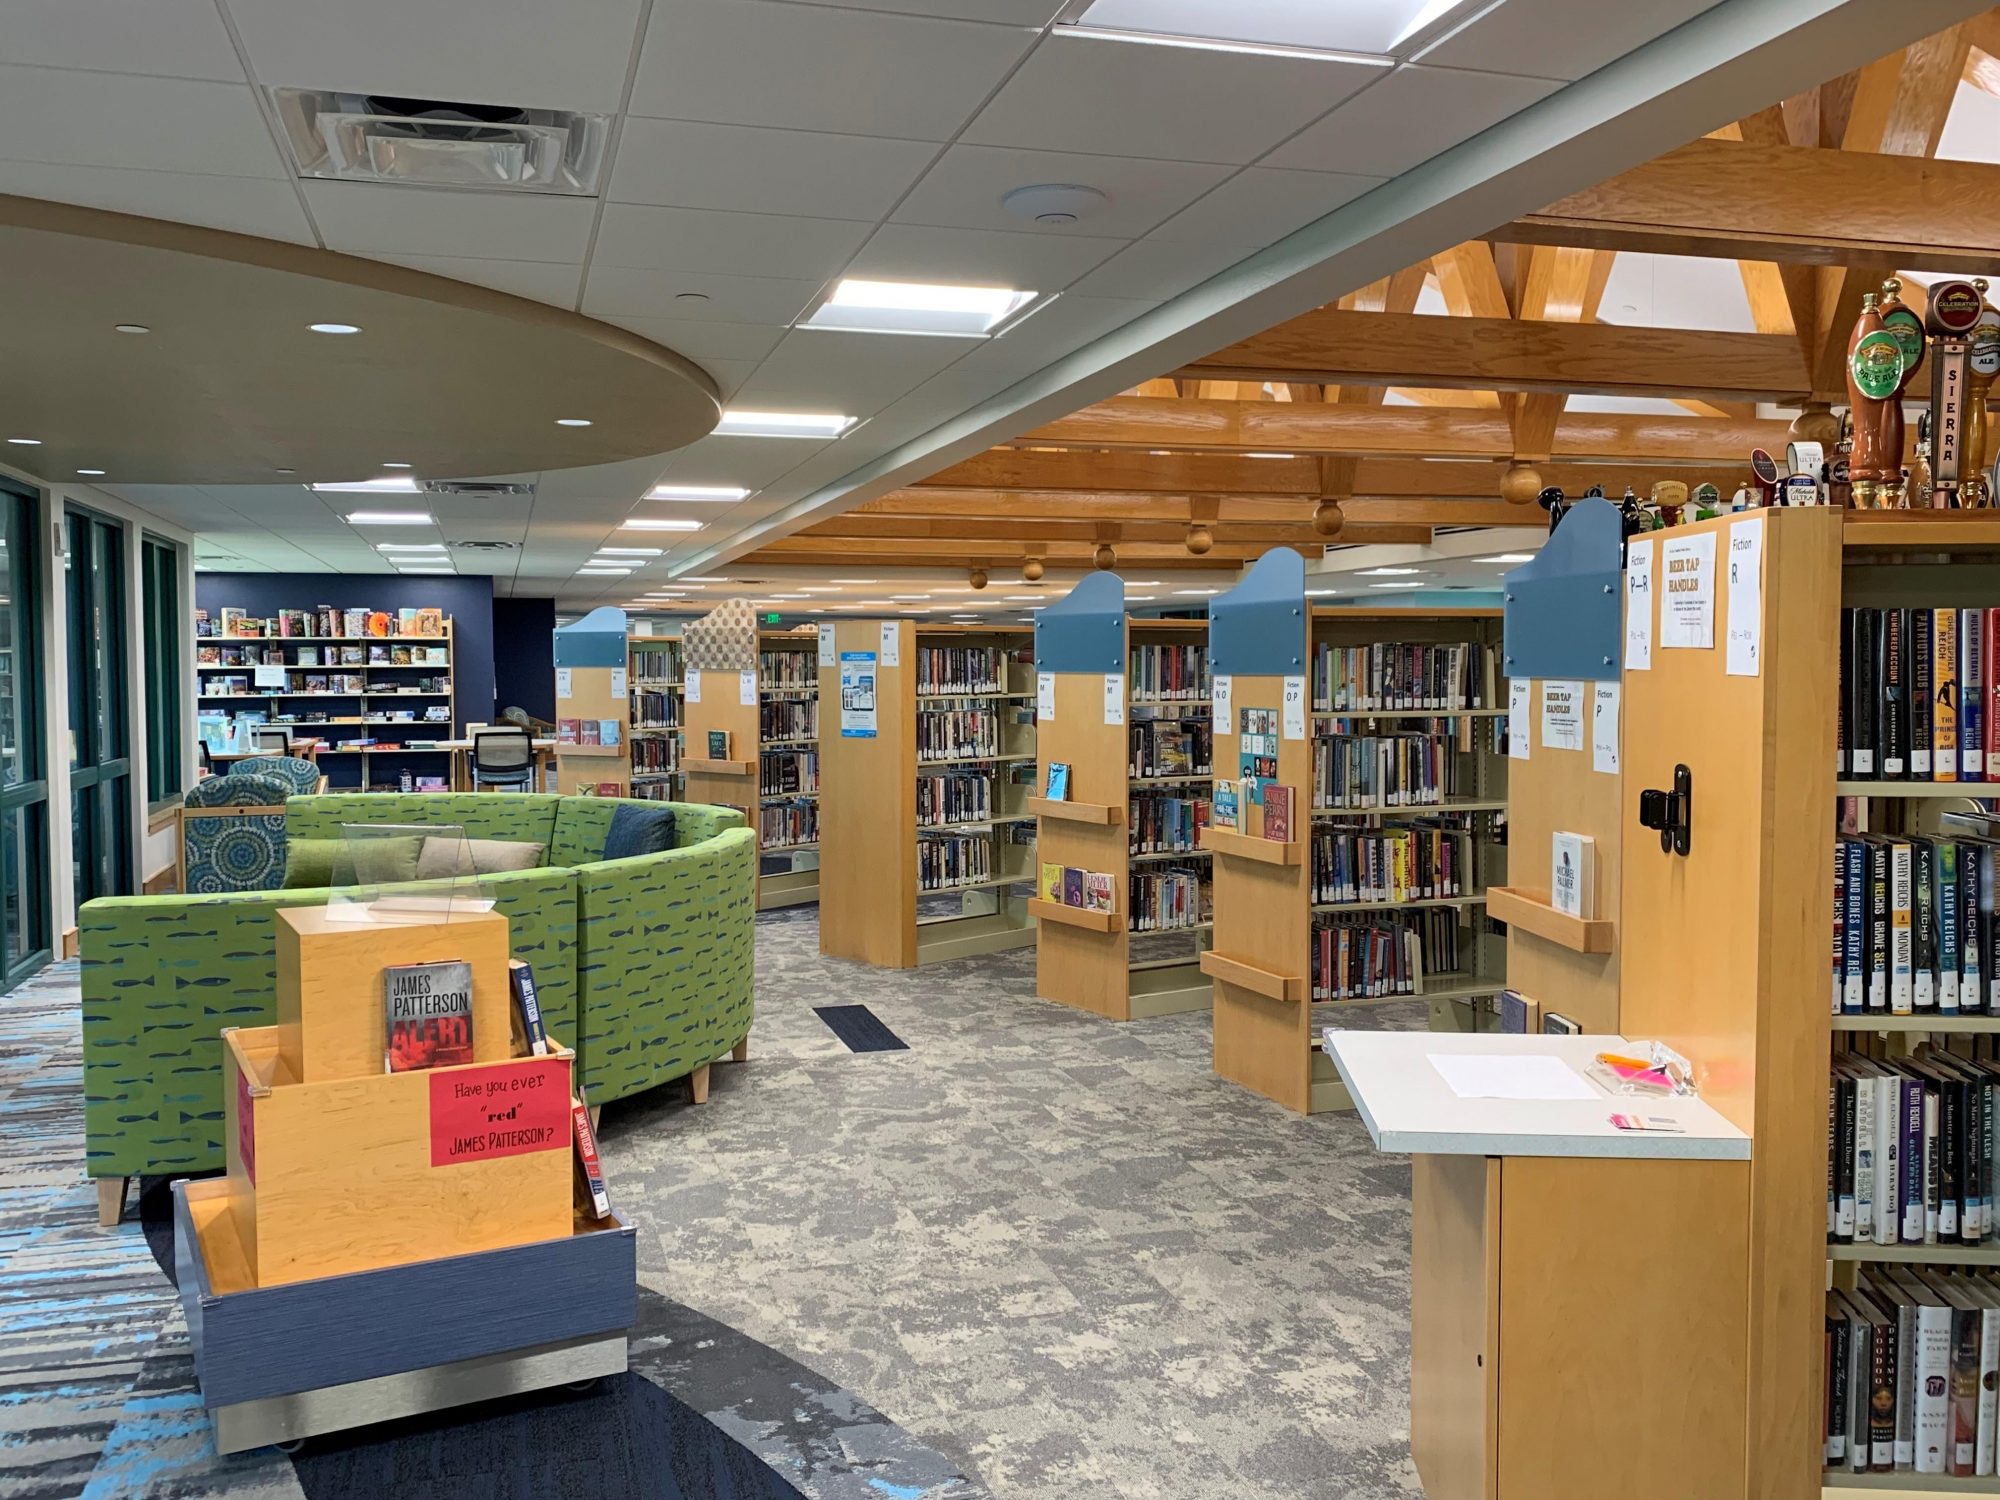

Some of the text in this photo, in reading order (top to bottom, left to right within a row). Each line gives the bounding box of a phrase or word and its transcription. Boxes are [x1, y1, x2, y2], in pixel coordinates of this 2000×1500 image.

[1882, 368, 1899, 382] ALE
[1943, 369, 1957, 461] SIERRA
[1732, 538, 1752, 552] Fiction
[1631, 555, 1646, 566] Fiction
[1668, 557, 1700, 573] BEER TAP
[1668, 577, 1699, 593] HANDLES
[1731, 563, 1738, 584] R
[1890, 612, 1898, 650] NUMBERED
[1971, 637, 1978, 645] OF
[1916, 615, 1928, 688] PATRIOTS CLUB
[1938, 631, 1947, 660] REICH
[1890, 651, 1898, 684] ACCOUNT
[1107, 686, 1113, 694] M
[1215, 690, 1220, 699] N
[1286, 692, 1298, 702] O P
[1513, 684, 1526, 693] Fiction
[1546, 692, 1572, 702] BEER TAP
[1597, 690, 1613, 699] Fiction
[1512, 698, 1517, 709] P
[1546, 705, 1571, 714] HANDLES
[1596, 704, 1602, 717] P
[1850, 849, 1861, 874] FLASH
[1875, 851, 1885, 879] KATHY
[1850, 875, 1860, 893] AND
[1920, 851, 1929, 941] KATHY REICHS
[1849, 895, 1860, 924] BONES
[1874, 882, 1885, 915] REICHS
[1897, 852, 1909, 965] KATHY REICHS MONDAY
[1967, 852, 1976, 947] KATHY REICHS
[1944, 885, 1955, 954] KATHY REICHS
[1848, 930, 1860, 956] KATHY
[1874, 920, 1885, 950] GRAVE
[393, 974, 431, 997] JAMES
[521, 978, 534, 996] JAMES
[394, 992, 468, 1017] PATTERSON
[525, 994, 539, 1023] PATTERSON
[391, 1016, 468, 1050] ALERT
[454, 1074, 545, 1099] Have you ever
[1970, 1094, 1977, 1104] No
[1846, 1094, 1854, 1108] The
[1909, 1087, 1920, 1133] RUTH RENDELL
[1983, 1085, 1992, 1159] NOT IN THE FLESH
[449, 1135, 485, 1156] JAMES
[574, 1112, 595, 1158] JAMES PATTERSON
[1845, 1126, 1853, 1144] Next
[1968, 1127, 1977, 1165] Nightingale
[1928, 1136, 1938, 1185] MEANS
